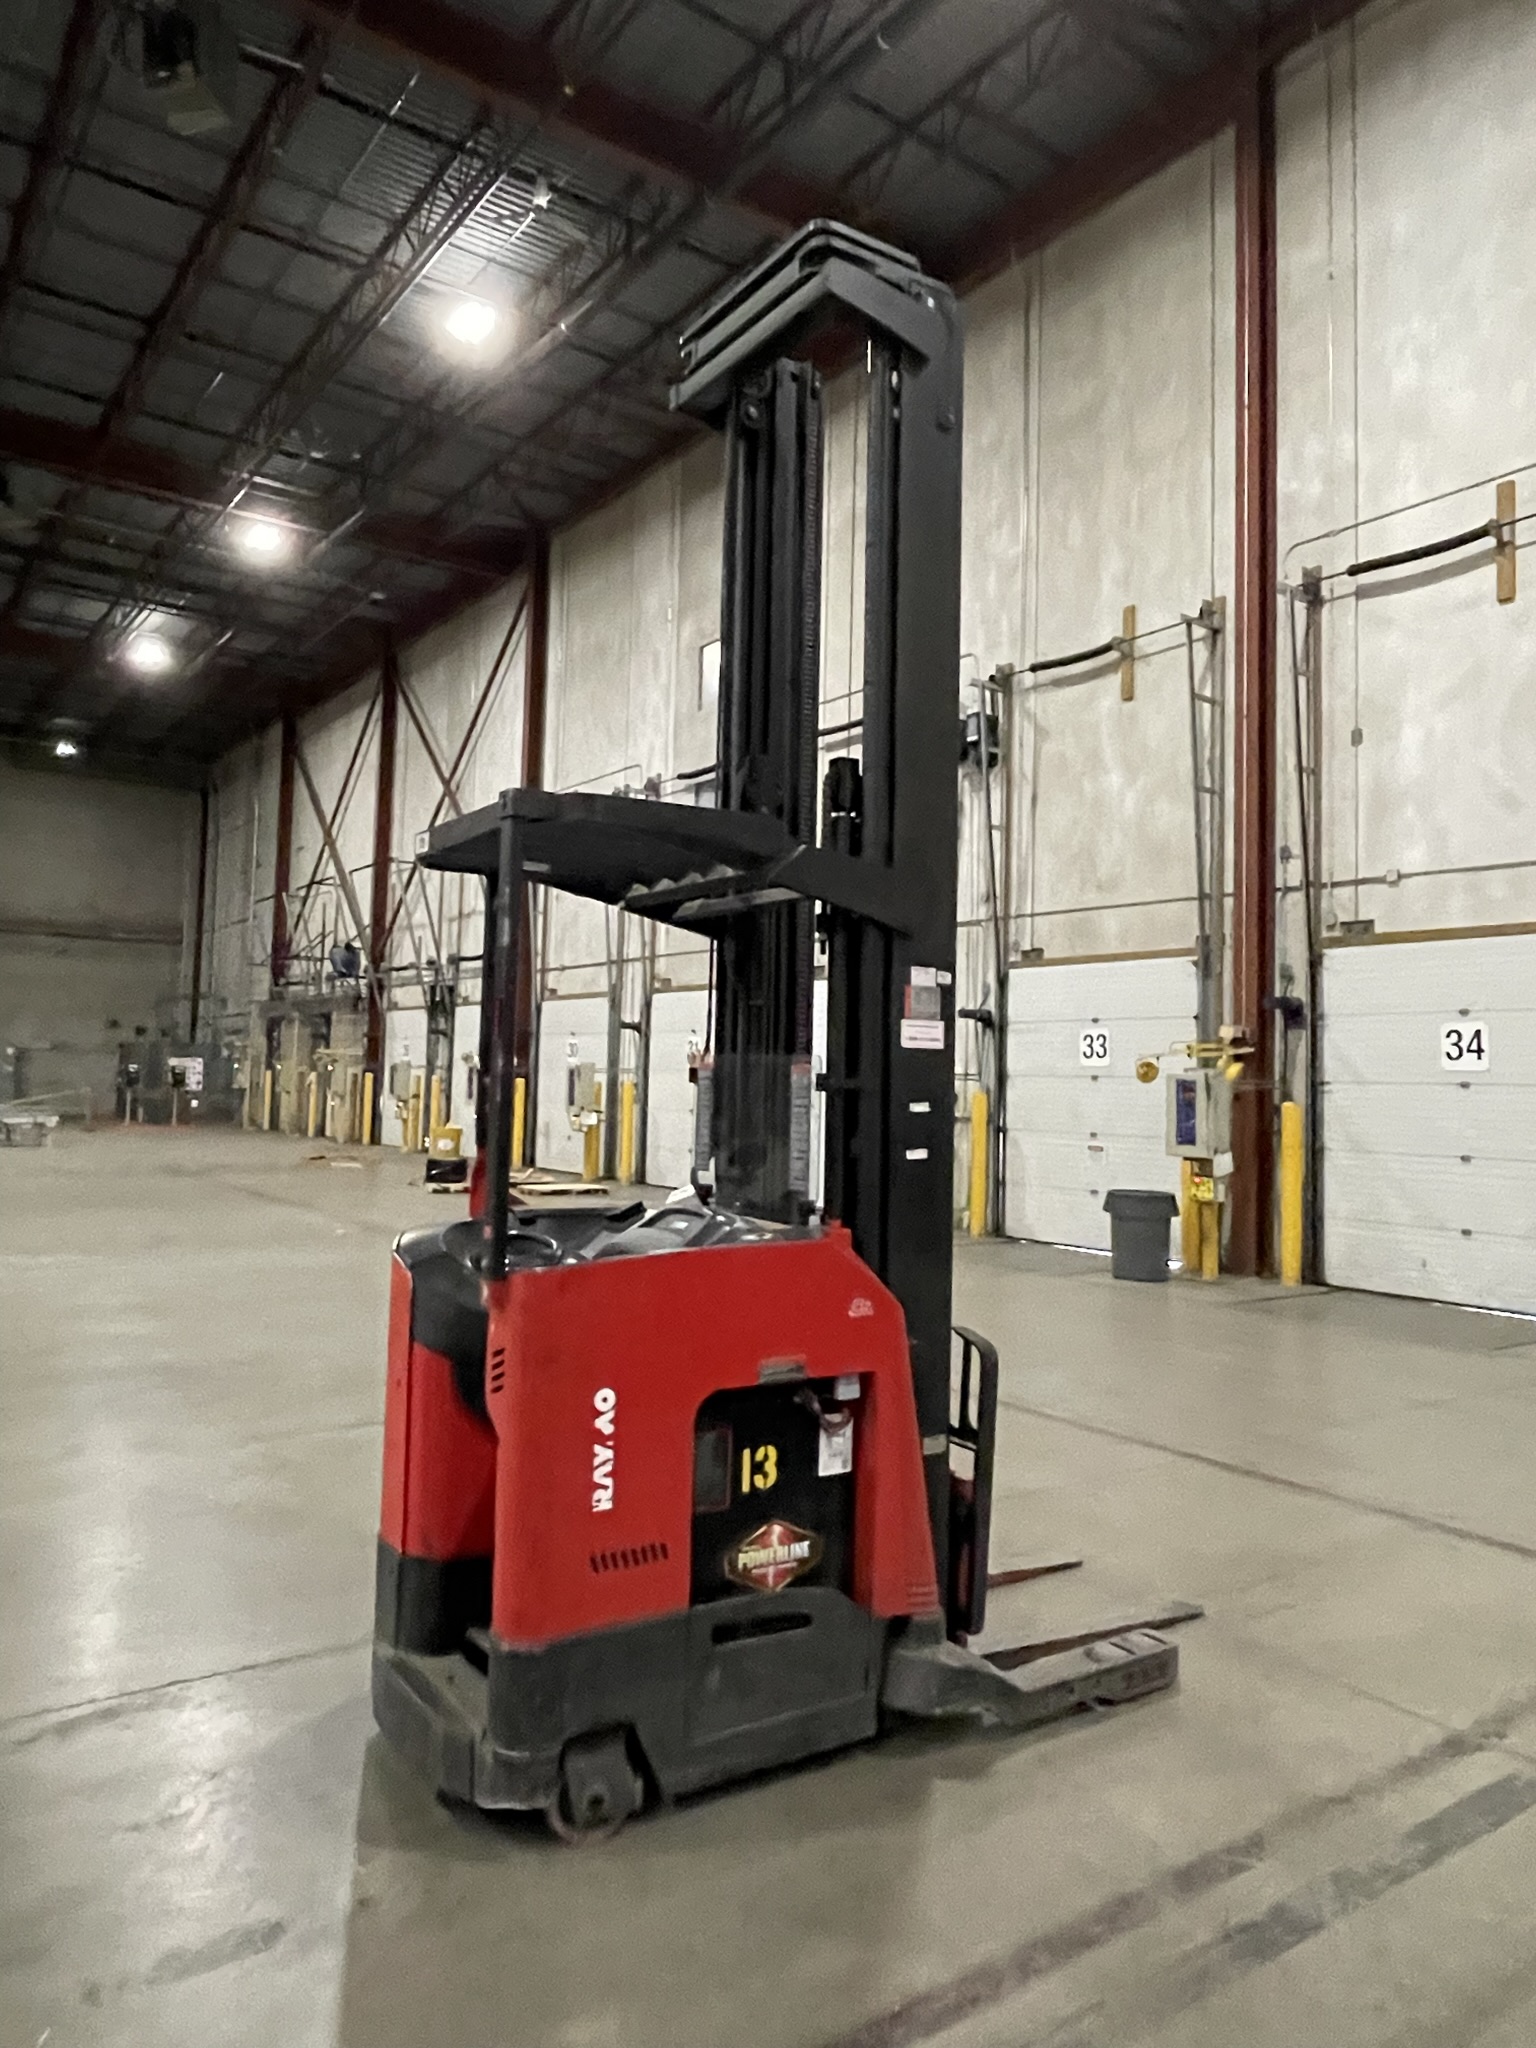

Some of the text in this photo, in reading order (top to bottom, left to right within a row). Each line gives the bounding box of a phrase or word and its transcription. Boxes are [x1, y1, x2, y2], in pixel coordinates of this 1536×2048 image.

[1082, 1033, 1107, 1059] 33
[1445, 1029, 1485, 1061] 34
[742, 1445, 778, 1493] 13
